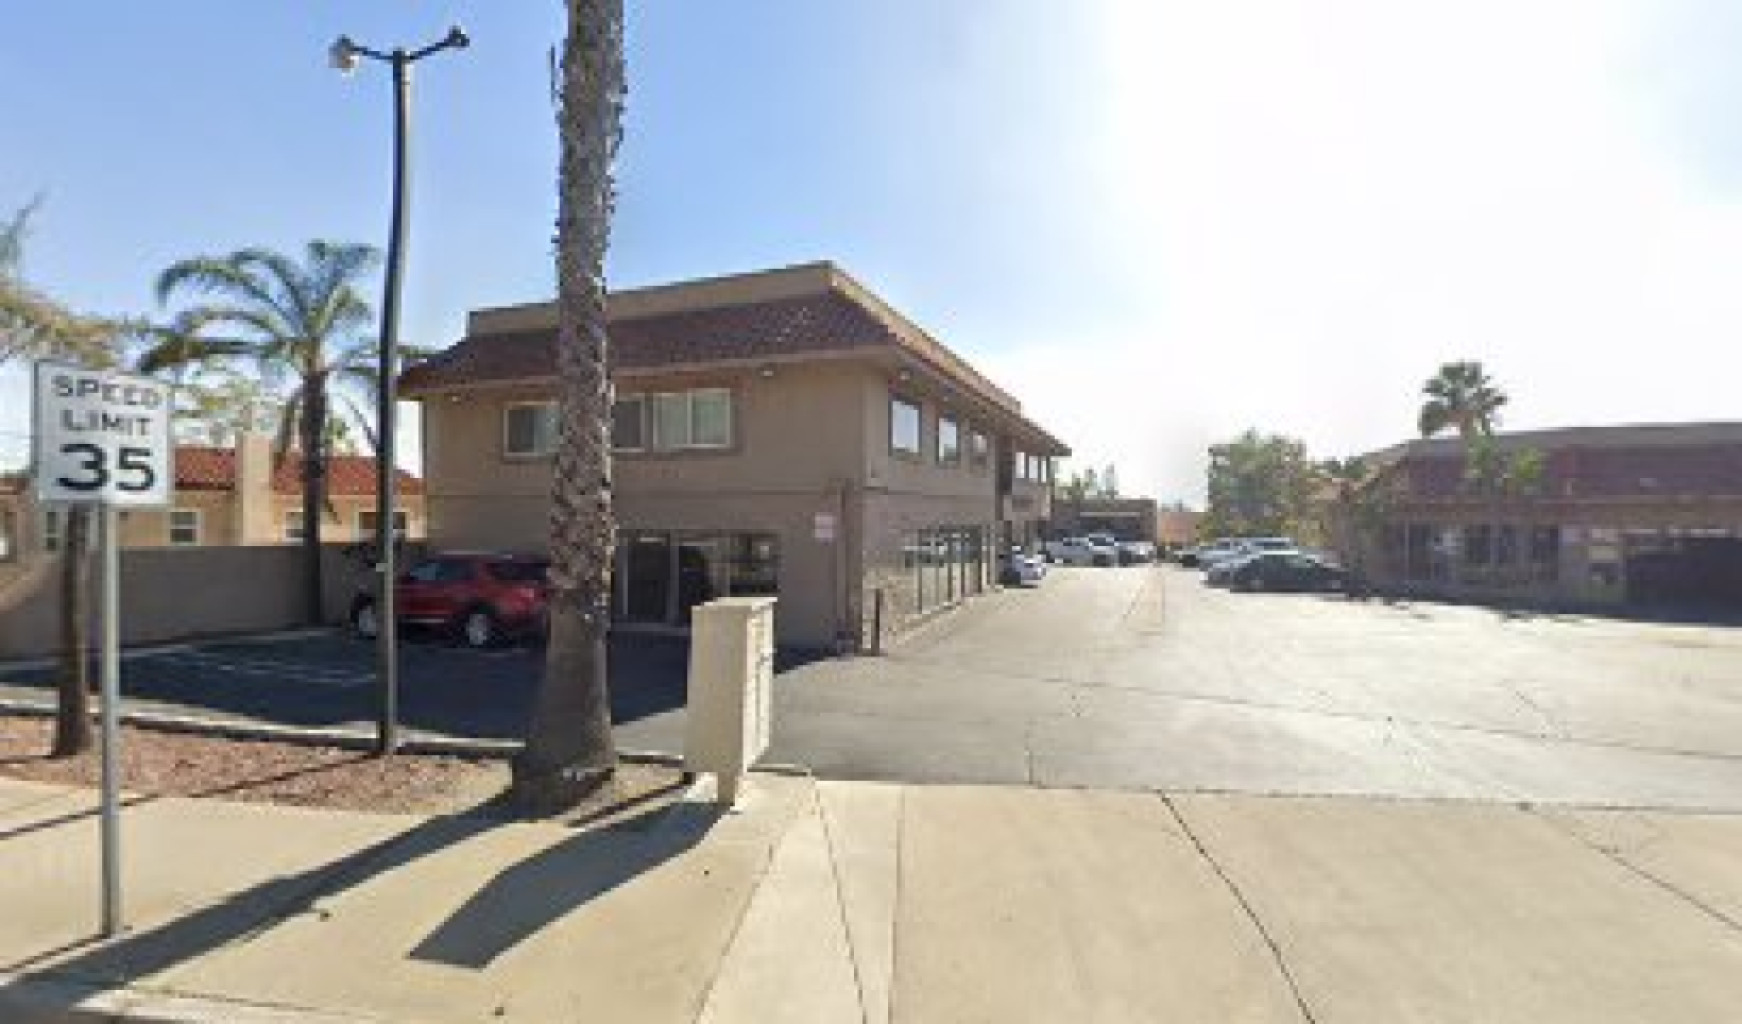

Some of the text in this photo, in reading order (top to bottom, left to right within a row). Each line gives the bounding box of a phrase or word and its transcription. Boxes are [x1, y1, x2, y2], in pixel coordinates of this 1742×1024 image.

[52, 375, 162, 408] SPEED
[60, 409, 153, 436] LIMIT
[57, 443, 154, 491] 35
